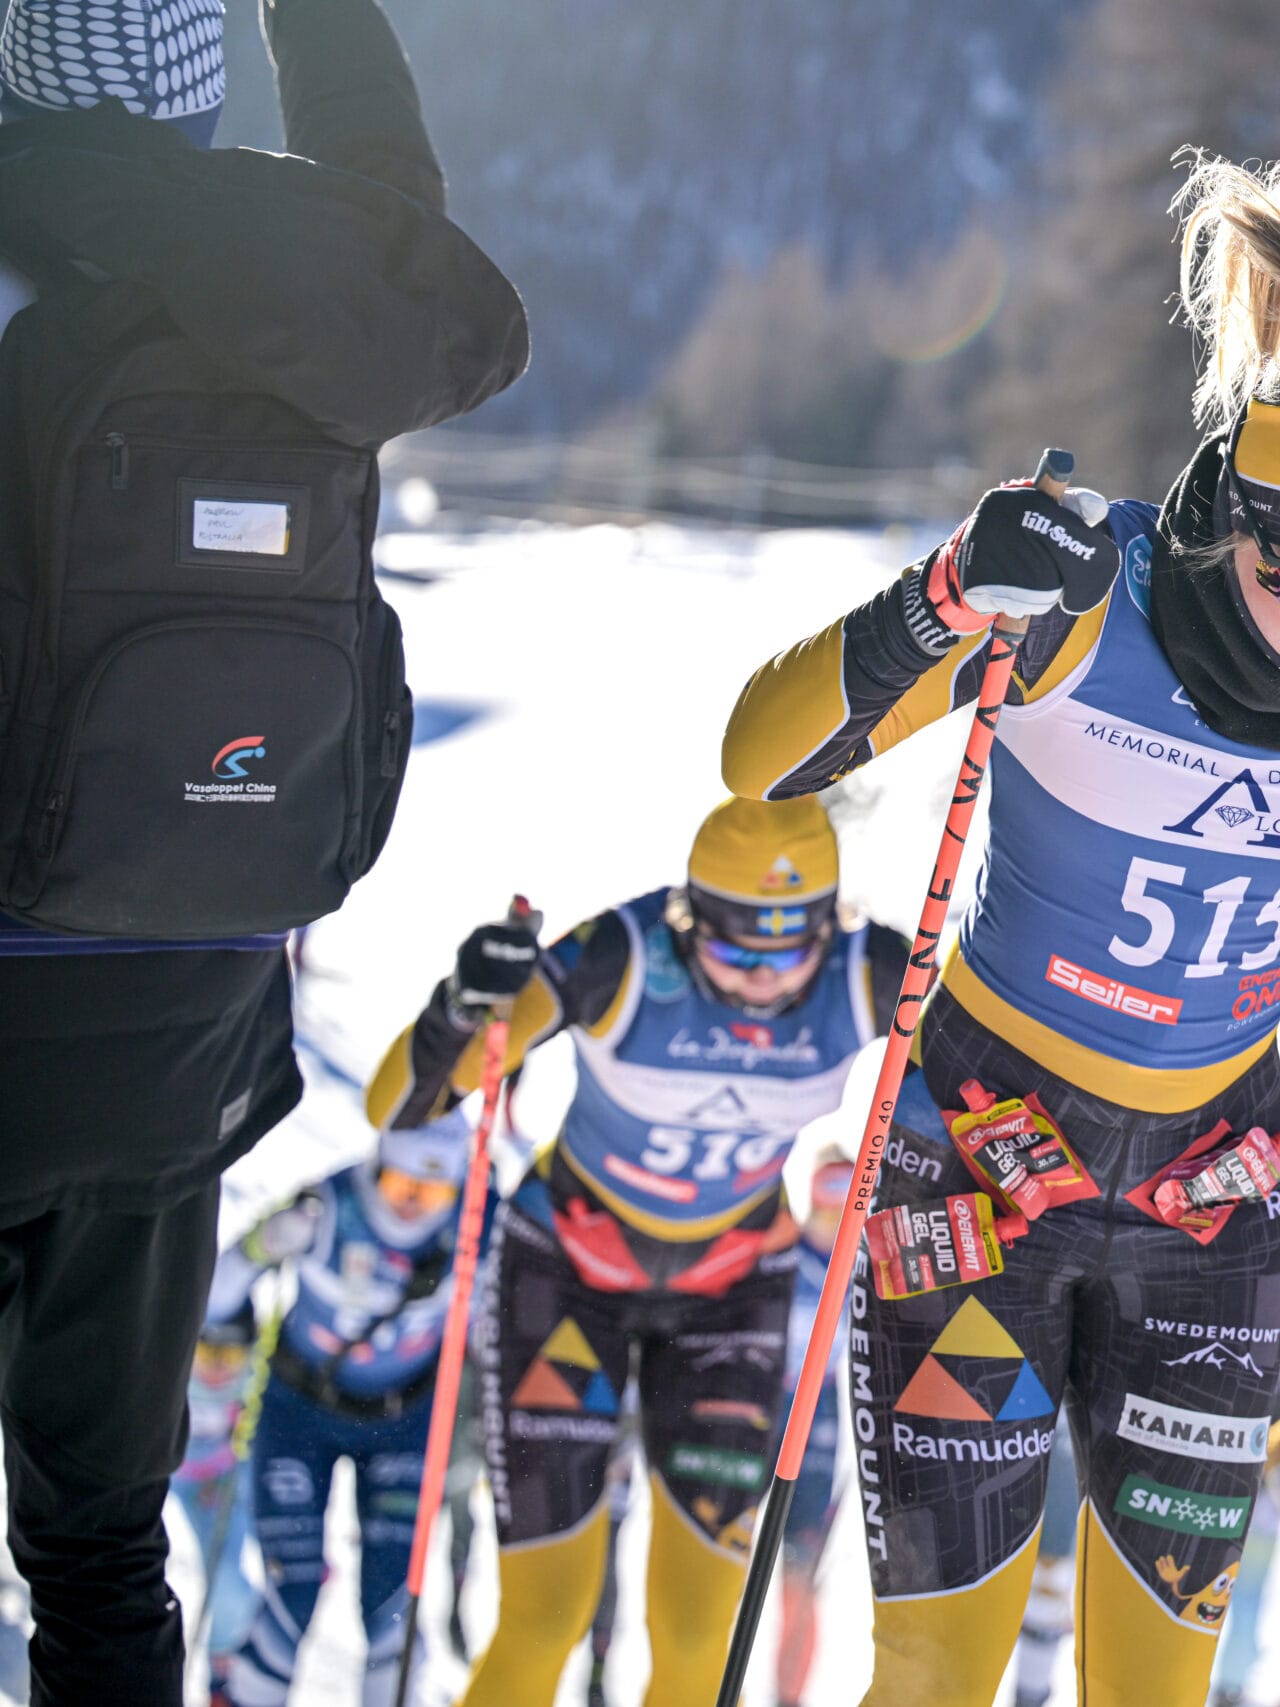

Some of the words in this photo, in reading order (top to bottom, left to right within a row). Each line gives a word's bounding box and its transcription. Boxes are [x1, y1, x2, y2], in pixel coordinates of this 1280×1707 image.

[1084, 721, 1220, 777] MEMORIAL
[185, 782, 243, 794] Vasaloppet
[246, 783, 276, 793] China
[1050, 959, 1174, 1021] Seiler
[854, 1134, 885, 1211] PREMIO
[879, 1100, 894, 1124] 40
[1216, 1165, 1232, 1187] GEL
[911, 1212, 930, 1244] GEL
[928, 1211, 957, 1273] LIQUID
[958, 1219, 980, 1273] ENERVIT
[1144, 1317, 1280, 1343] SWEDEMOUNT
[1128, 1408, 1245, 1449] KANARI
